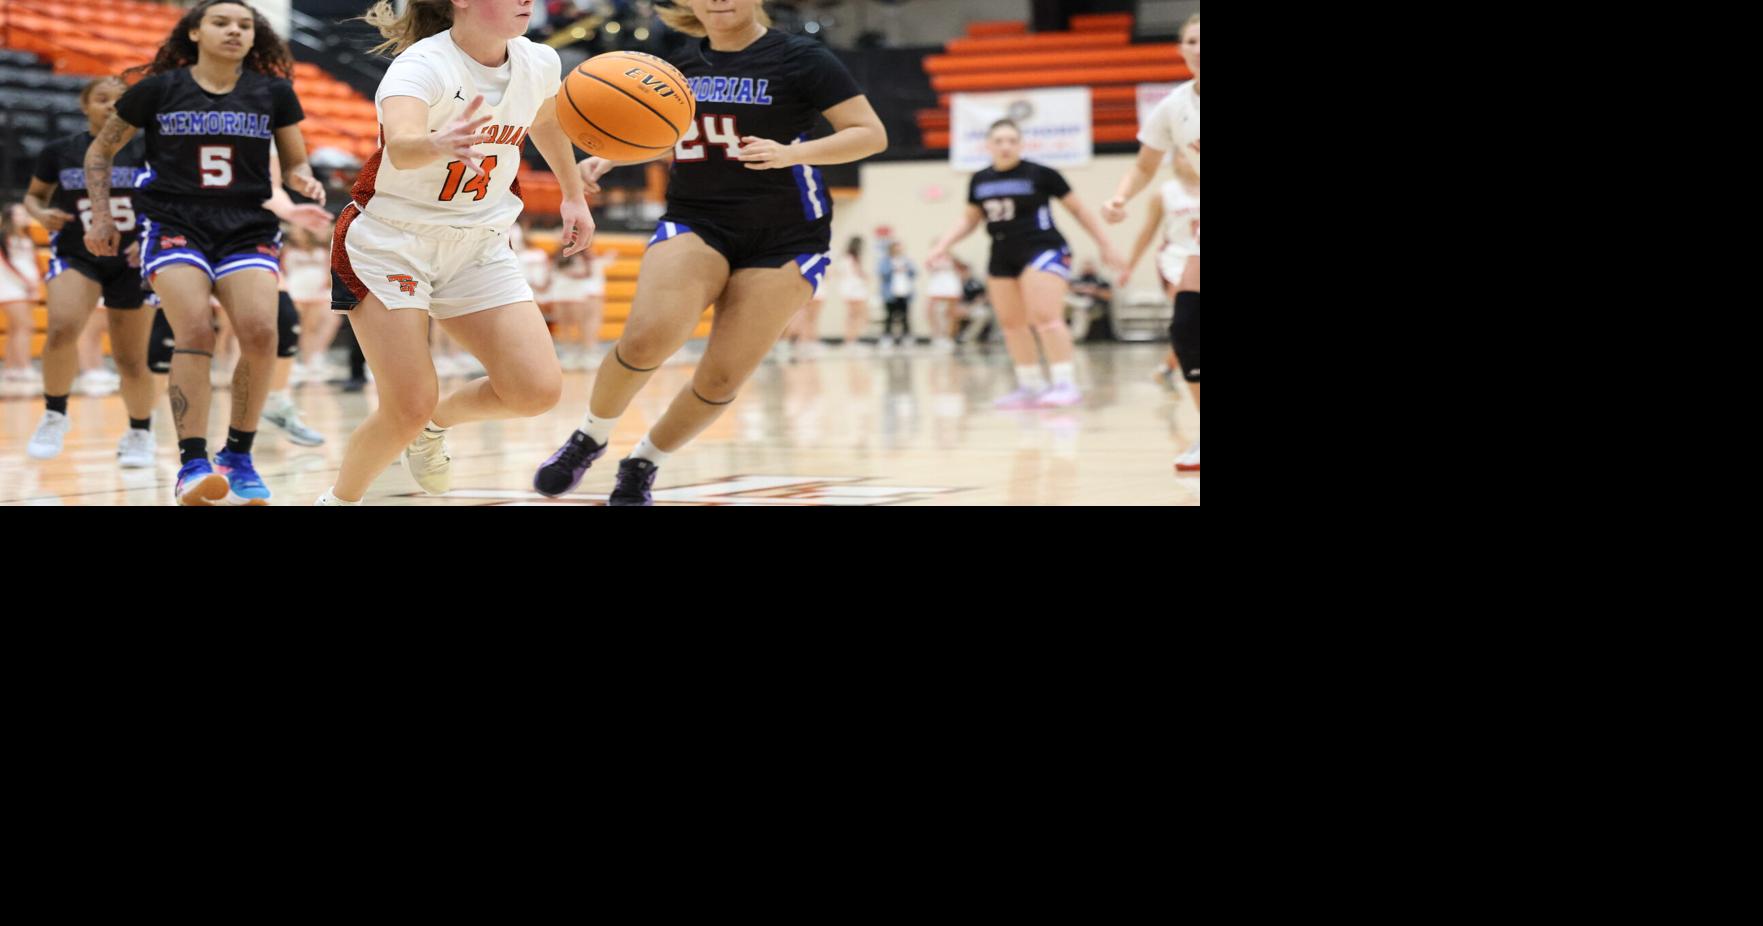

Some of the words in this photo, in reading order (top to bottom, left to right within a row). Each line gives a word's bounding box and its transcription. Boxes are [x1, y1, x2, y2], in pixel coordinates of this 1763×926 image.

[624, 67, 675, 97] EVO
[157, 111, 272, 138] MEMORIAL
[673, 113, 746, 164] 24
[199, 145, 234, 189] 5
[438, 155, 498, 201] 14
